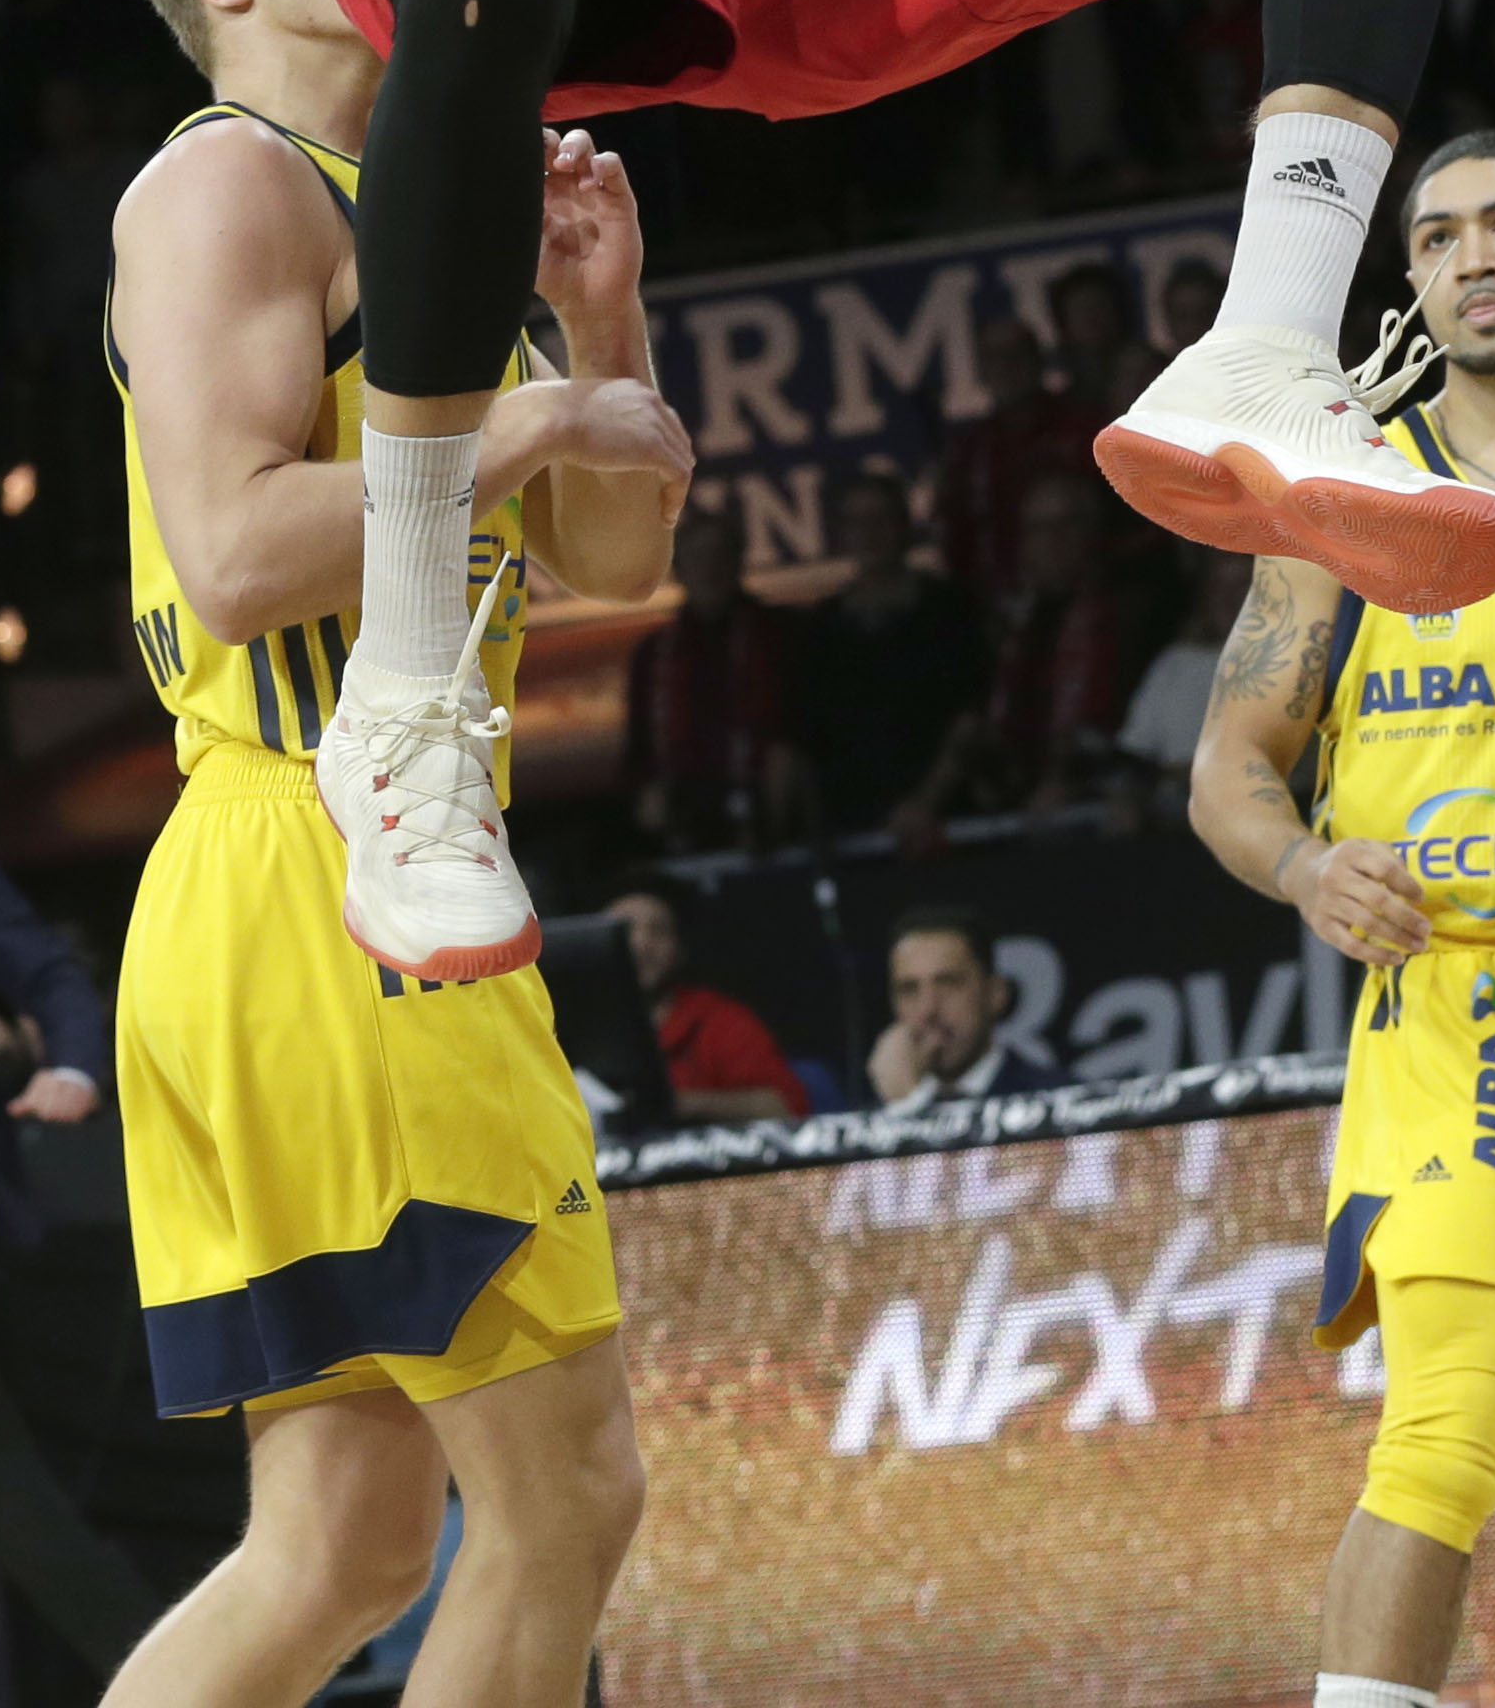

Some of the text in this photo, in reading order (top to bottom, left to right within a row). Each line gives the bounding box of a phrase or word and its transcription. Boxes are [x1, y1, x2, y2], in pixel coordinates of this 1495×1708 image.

[1273, 170, 1346, 198] adidas
[1358, 728, 1380, 745] Wir
[1385, 725, 1449, 742] nennen
[1455, 722, 1476, 737] es
[829, 1214, 1327, 1457] NEXT
